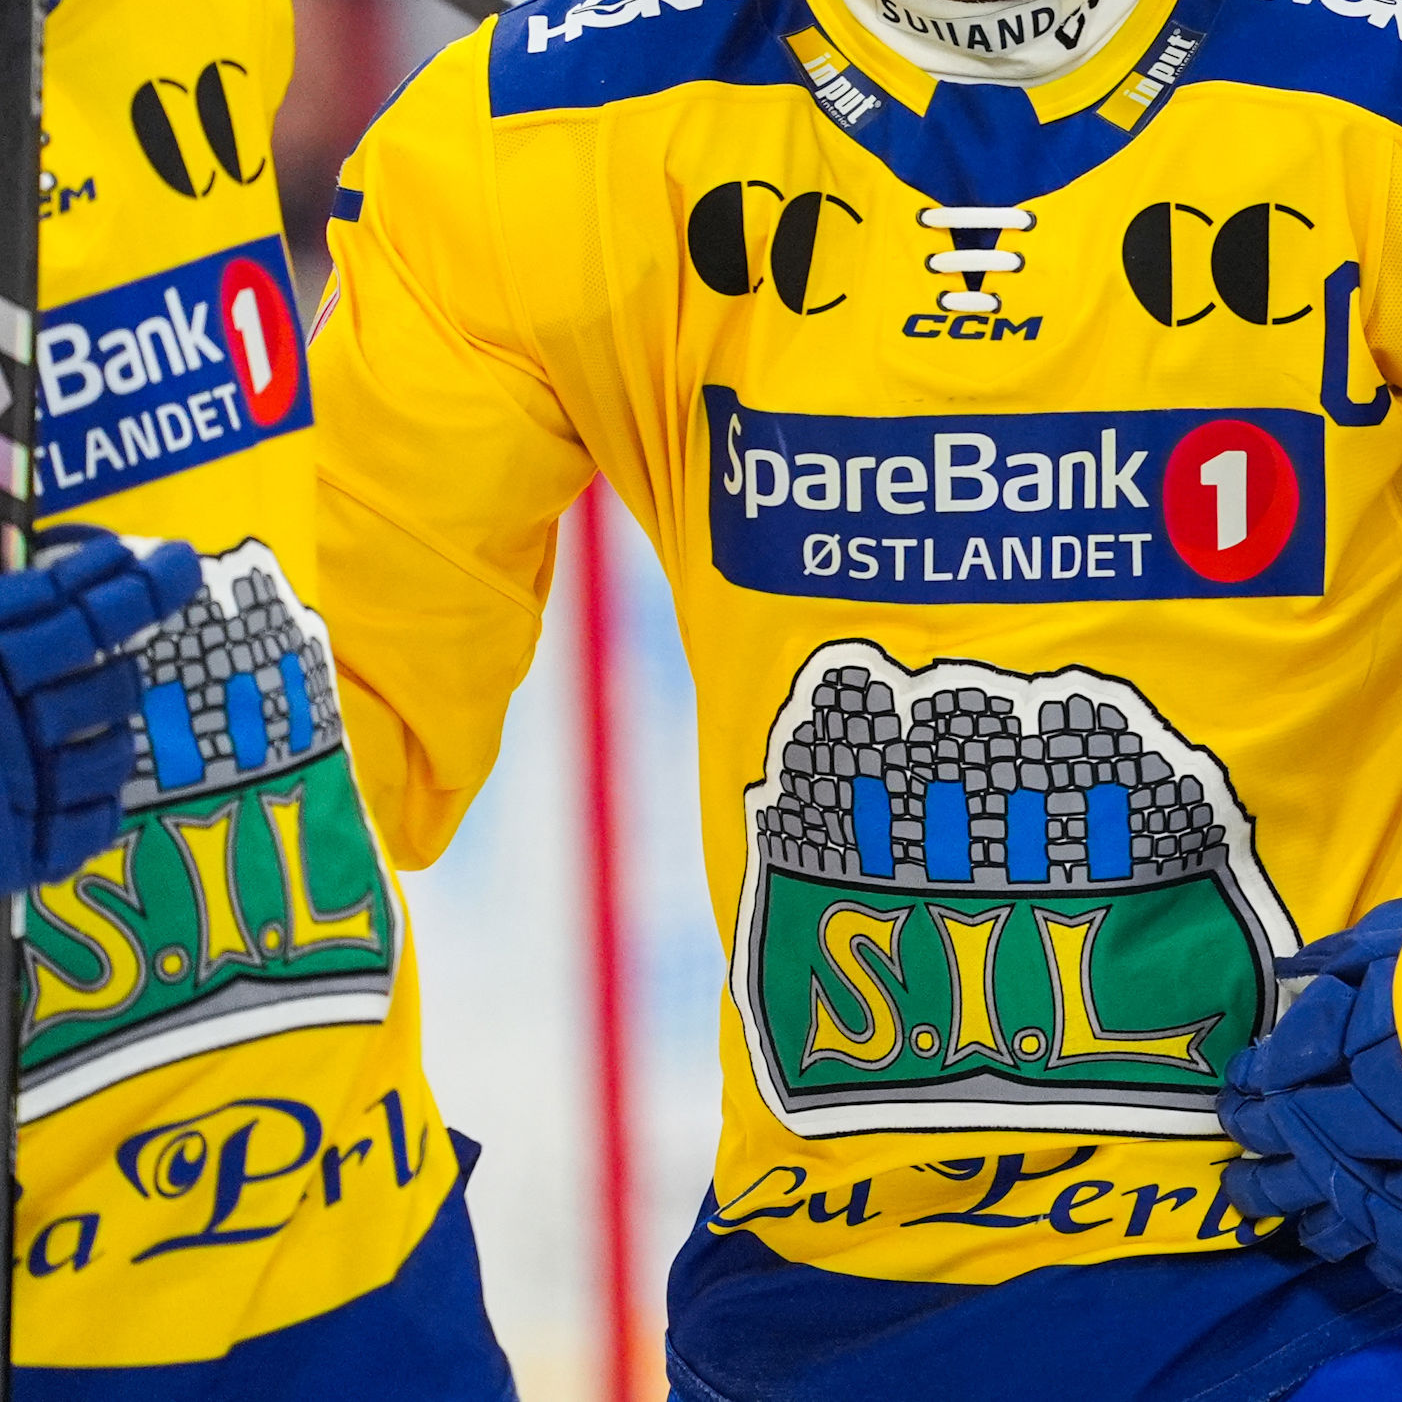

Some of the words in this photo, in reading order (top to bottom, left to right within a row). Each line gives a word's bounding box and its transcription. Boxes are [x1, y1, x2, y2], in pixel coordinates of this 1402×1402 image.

[803, 51, 877, 125] input
[1123, 33, 1196, 107] input
[820, 99, 852, 129] interior
[231, 286, 273, 395] 1
[902, 314, 1044, 341] CCM
[32, 381, 242, 497] TLANDET
[722, 412, 1150, 520] SpareBank
[1200, 449, 1248, 552] 1
[802, 533, 1153, 582] ØSTLANDET
